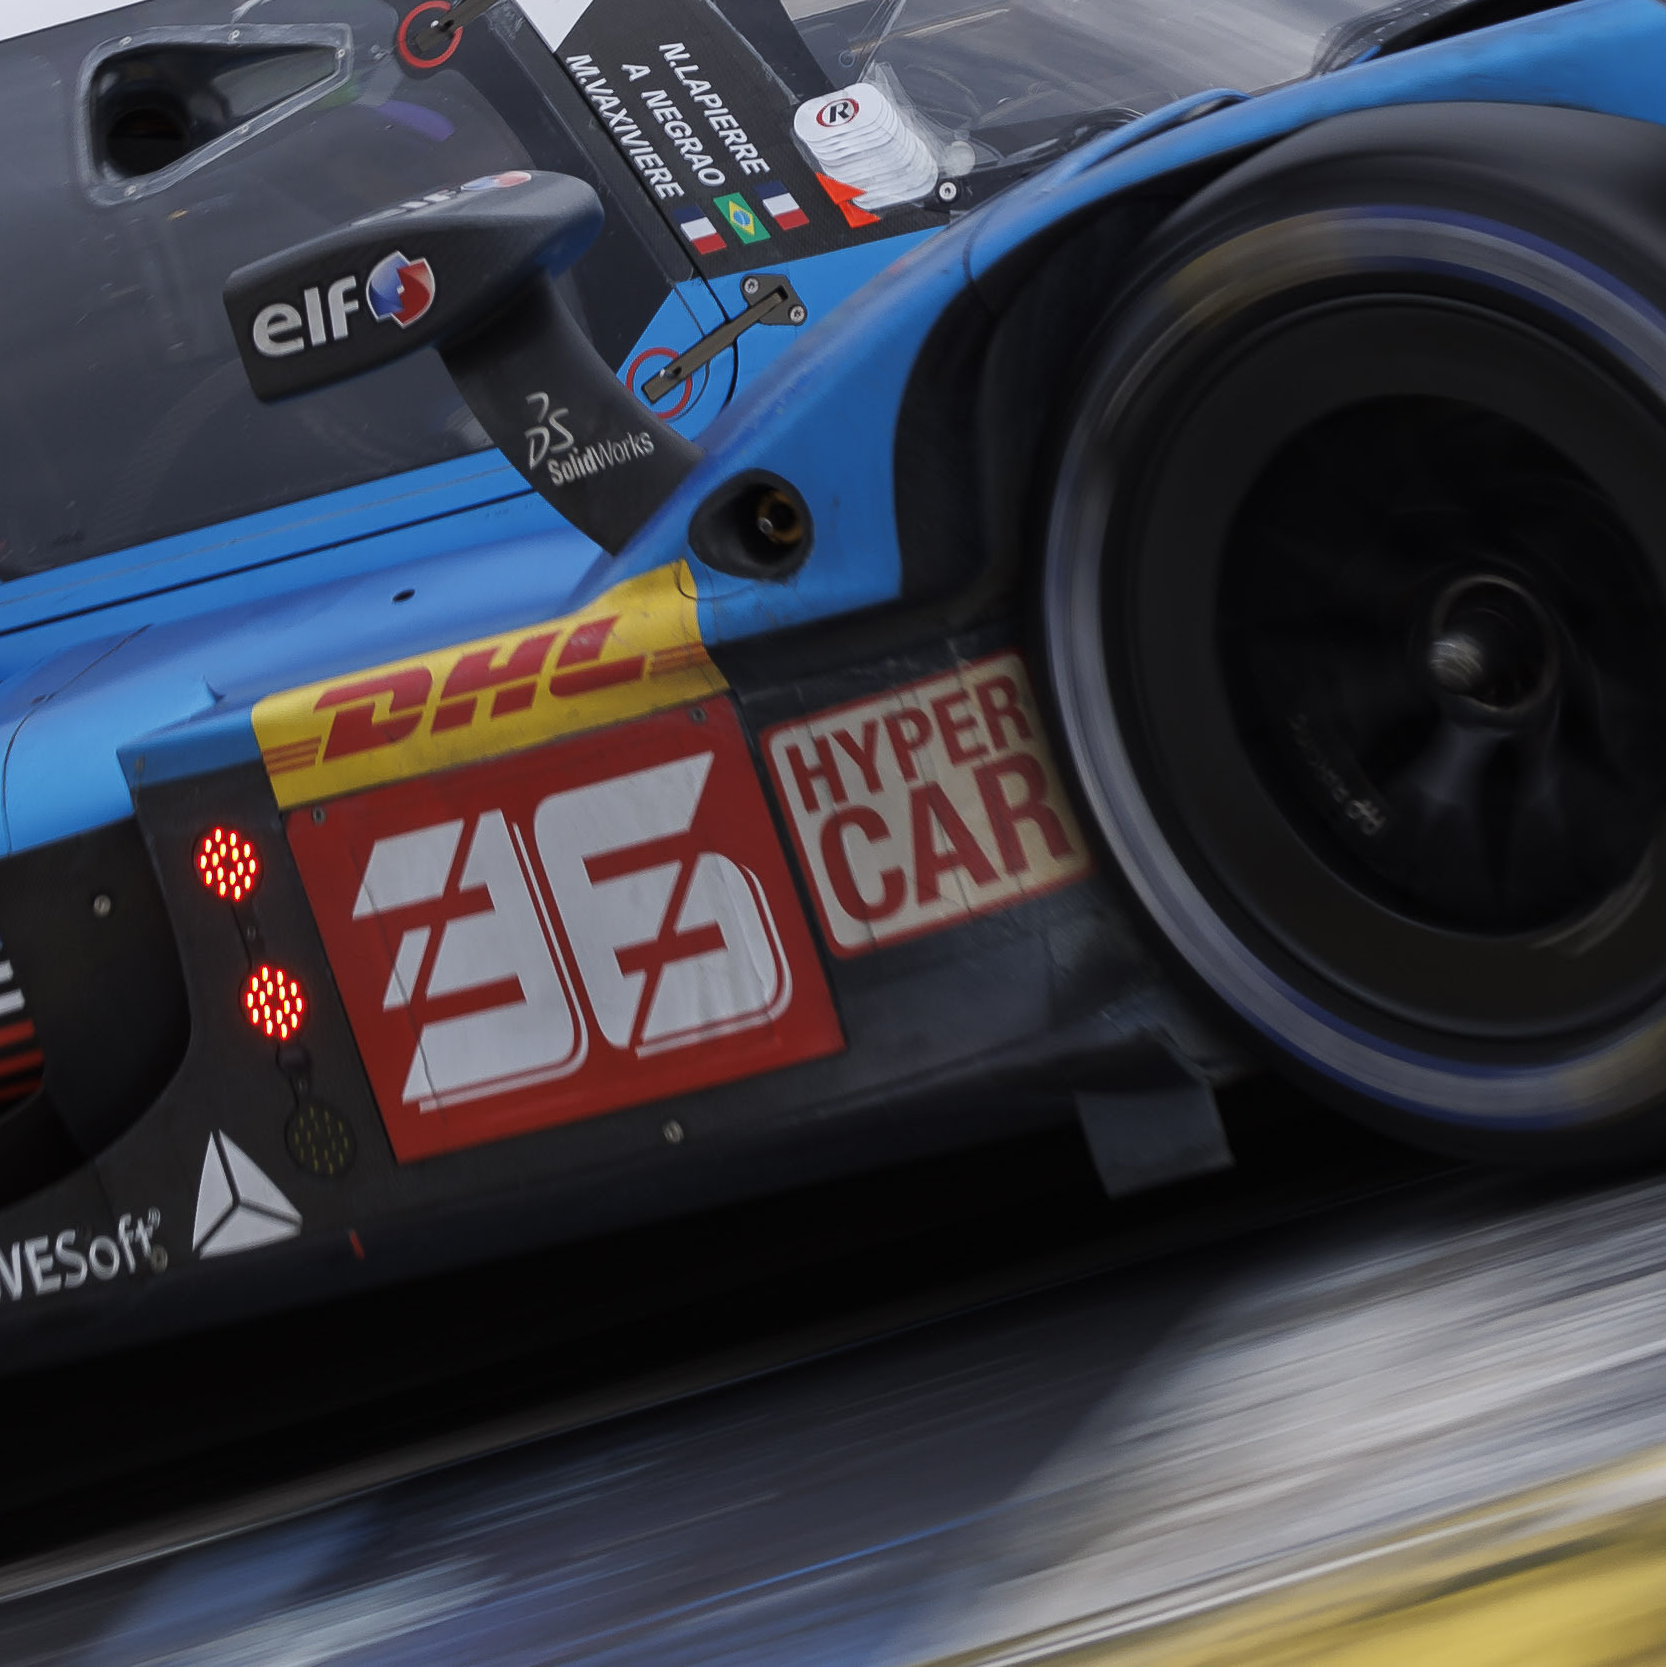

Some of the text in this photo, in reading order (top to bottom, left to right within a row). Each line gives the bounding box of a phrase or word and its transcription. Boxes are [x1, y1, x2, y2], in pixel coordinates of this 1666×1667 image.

[566, 53, 685, 200] M.VAXIVIERE
[621, 62, 726, 188] A NEGRAO
[658, 42, 771, 176] N.LAPIERRE
[252, 275, 359, 358] elf
[546, 431, 655, 487] SolidWorks
[321, 614, 651, 764] DHL
[786, 673, 1035, 815] HYPER
[819, 757, 1072, 924] CAR
[351, 750, 794, 1114] 36
